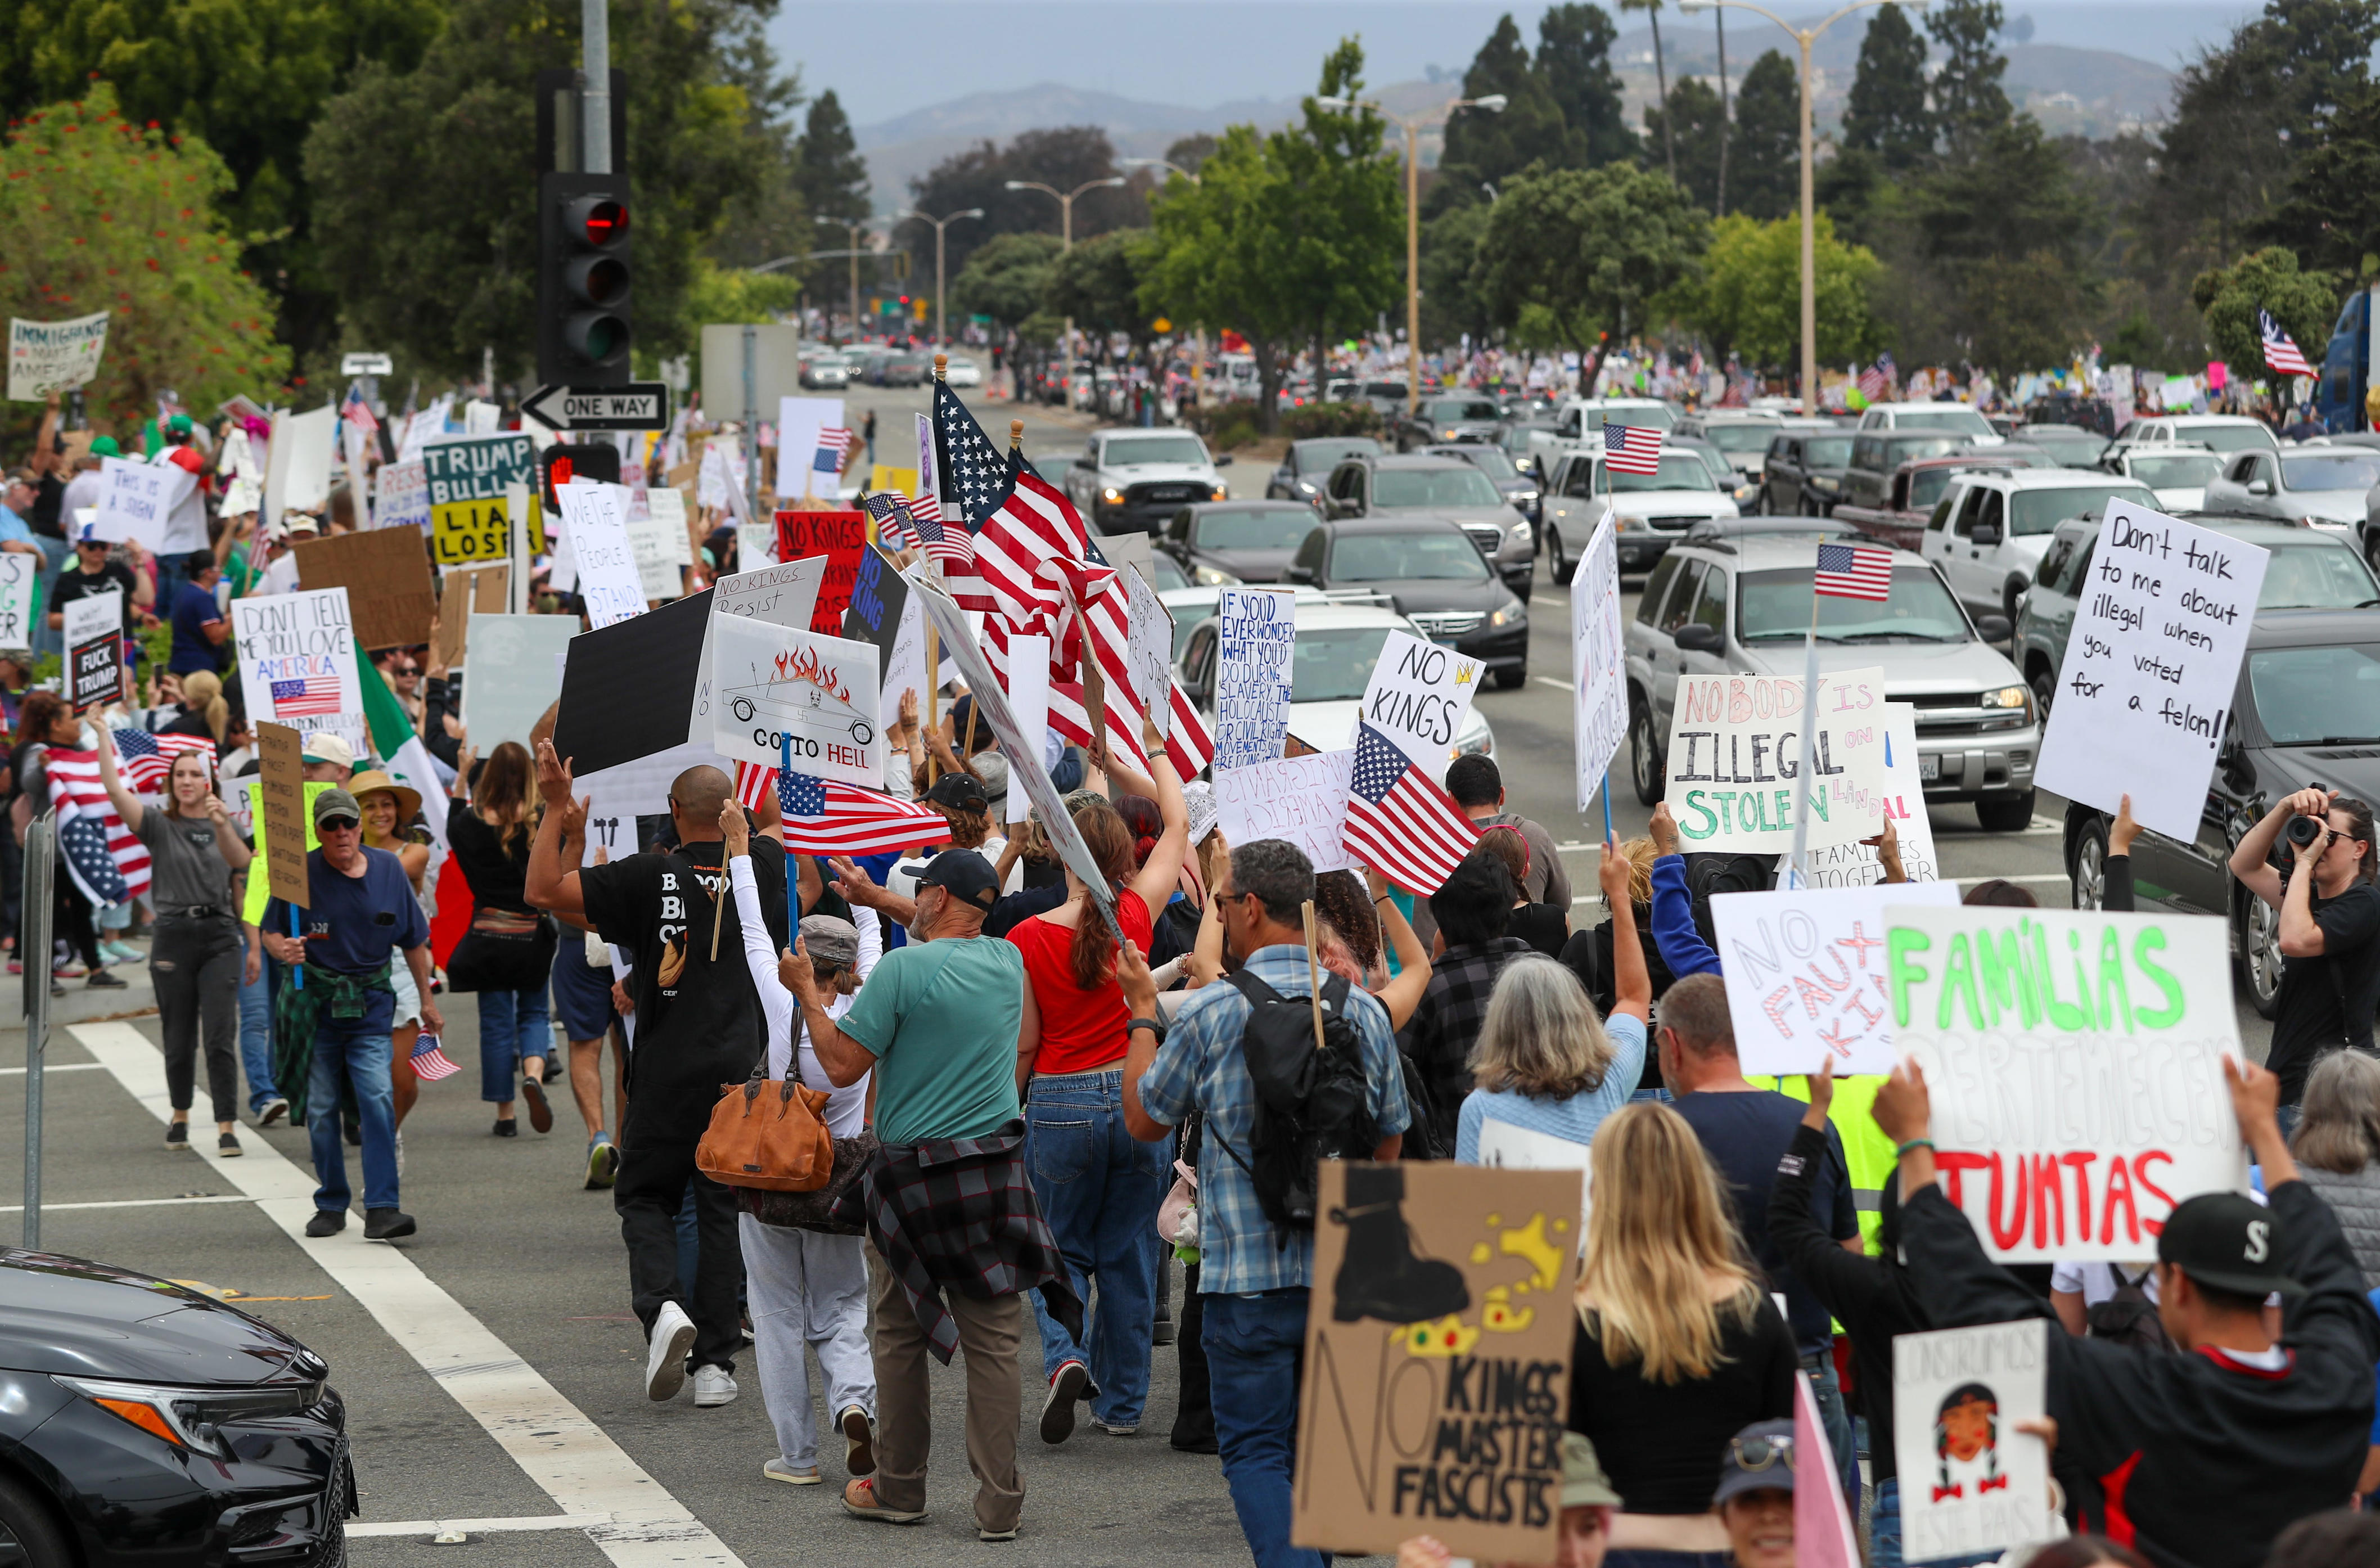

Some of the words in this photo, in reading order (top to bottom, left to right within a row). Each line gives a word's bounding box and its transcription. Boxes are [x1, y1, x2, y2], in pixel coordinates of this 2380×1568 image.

[564, 398, 602, 415] ONE
[611, 398, 650, 414] WAY
[424, 439, 529, 475] TRUMP
[115, 468, 139, 490] THIS
[147, 480, 161, 496] IS
[431, 466, 531, 504] BULLY
[109, 494, 116, 511] A
[124, 497, 156, 521] SIGN
[447, 506, 507, 530] LIA
[781, 516, 806, 548] NO
[2111, 515, 2172, 560] Don't
[2183, 539, 2233, 581] talk
[575, 535, 625, 571] PEOPLE
[859, 544, 881, 589] NO
[719, 579, 740, 595] NO
[748, 567, 799, 589] KINGS
[2099, 557, 2122, 584] to
[2131, 569, 2162, 598] me
[2180, 588, 2238, 626] about
[310, 594, 348, 627] TELL
[590, 585, 638, 612] STAND
[716, 589, 783, 616] Resist
[851, 576, 884, 632] KING
[1223, 593, 1236, 614] IF
[1241, 594, 1275, 622] YOU'D
[1223, 616, 1256, 640] EVER
[1257, 620, 1295, 643] WONDER
[2092, 593, 2143, 632] illegal
[2163, 620, 2213, 653] when
[81, 646, 111, 673] FUCK
[238, 636, 257, 661] ME
[265, 633, 293, 656] YOU
[296, 627, 348, 657] LOVE
[891, 638, 912, 660] erans
[1223, 640, 1255, 665] WHAT
[1257, 642, 1287, 666] YOU'D
[2084, 633, 2112, 659] you
[2134, 655, 2184, 685] voted
[77, 665, 118, 696] TRUMP
[257, 655, 336, 680] AMERICA
[1222, 662, 1239, 683] DO
[1243, 663, 1279, 683] DURING
[1398, 644, 1445, 685] NO
[1220, 683, 1273, 702] SLAVERY,
[1277, 684, 1292, 702] THE
[1684, 678, 1828, 724] NOBODY
[1832, 684, 1874, 712] IS
[1371, 687, 1458, 745] KINGS
[2070, 672, 2104, 699] for
[2127, 695, 2143, 711] a
[2158, 697, 2224, 750] felon!
[1217, 723, 1233, 741] OR
[1236, 721, 1259, 741] CIVIL
[1260, 720, 1287, 741] RIGHTS
[1845, 727, 1873, 749] ON
[753, 728, 782, 750] GO
[790, 735, 819, 758] TO
[827, 743, 869, 769] HELL
[1214, 756, 1233, 770] ARE
[1679, 784, 1829, 840] STOLEN
[1832, 779, 1880, 817] LAND
[1816, 840, 1920, 865] FAMIES
[1814, 861, 1935, 889] TOGETER
[1732, 909, 1819, 990] NO
[2244, 1220, 2270, 1263] S
[1300, 1329, 1440, 1514] NO
[1446, 1354, 1563, 1415] KINGS
[1392, 1465, 1553, 1529] FASCISTS
